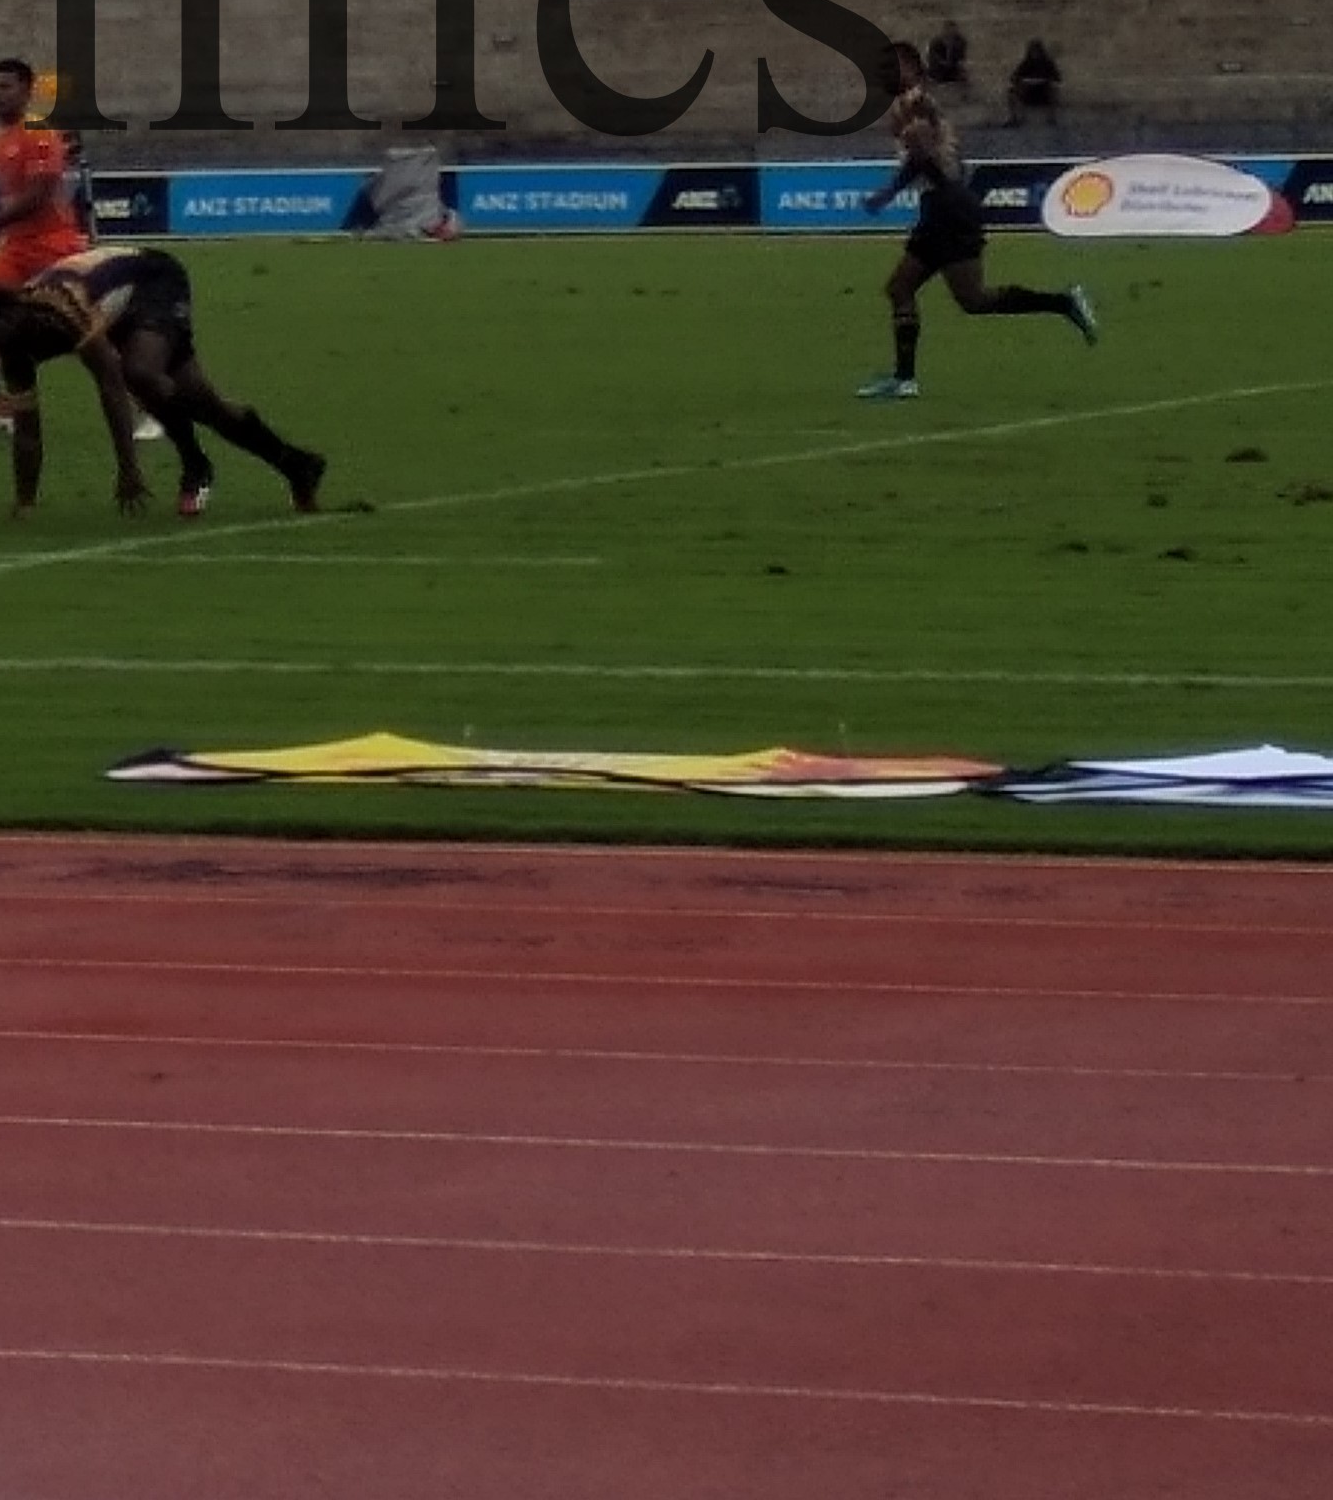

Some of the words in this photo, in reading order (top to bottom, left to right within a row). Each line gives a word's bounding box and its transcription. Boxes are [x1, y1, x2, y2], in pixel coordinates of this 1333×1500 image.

[471, 192, 518, 211] ANZ
[523, 191, 628, 211] STADIUM
[778, 191, 827, 210] ANZ
[981, 188, 1029, 207] ANZ
[1303, 183, 1333, 204] AN
[184, 198, 229, 216] ANZ
[235, 197, 331, 215] STADIUM
